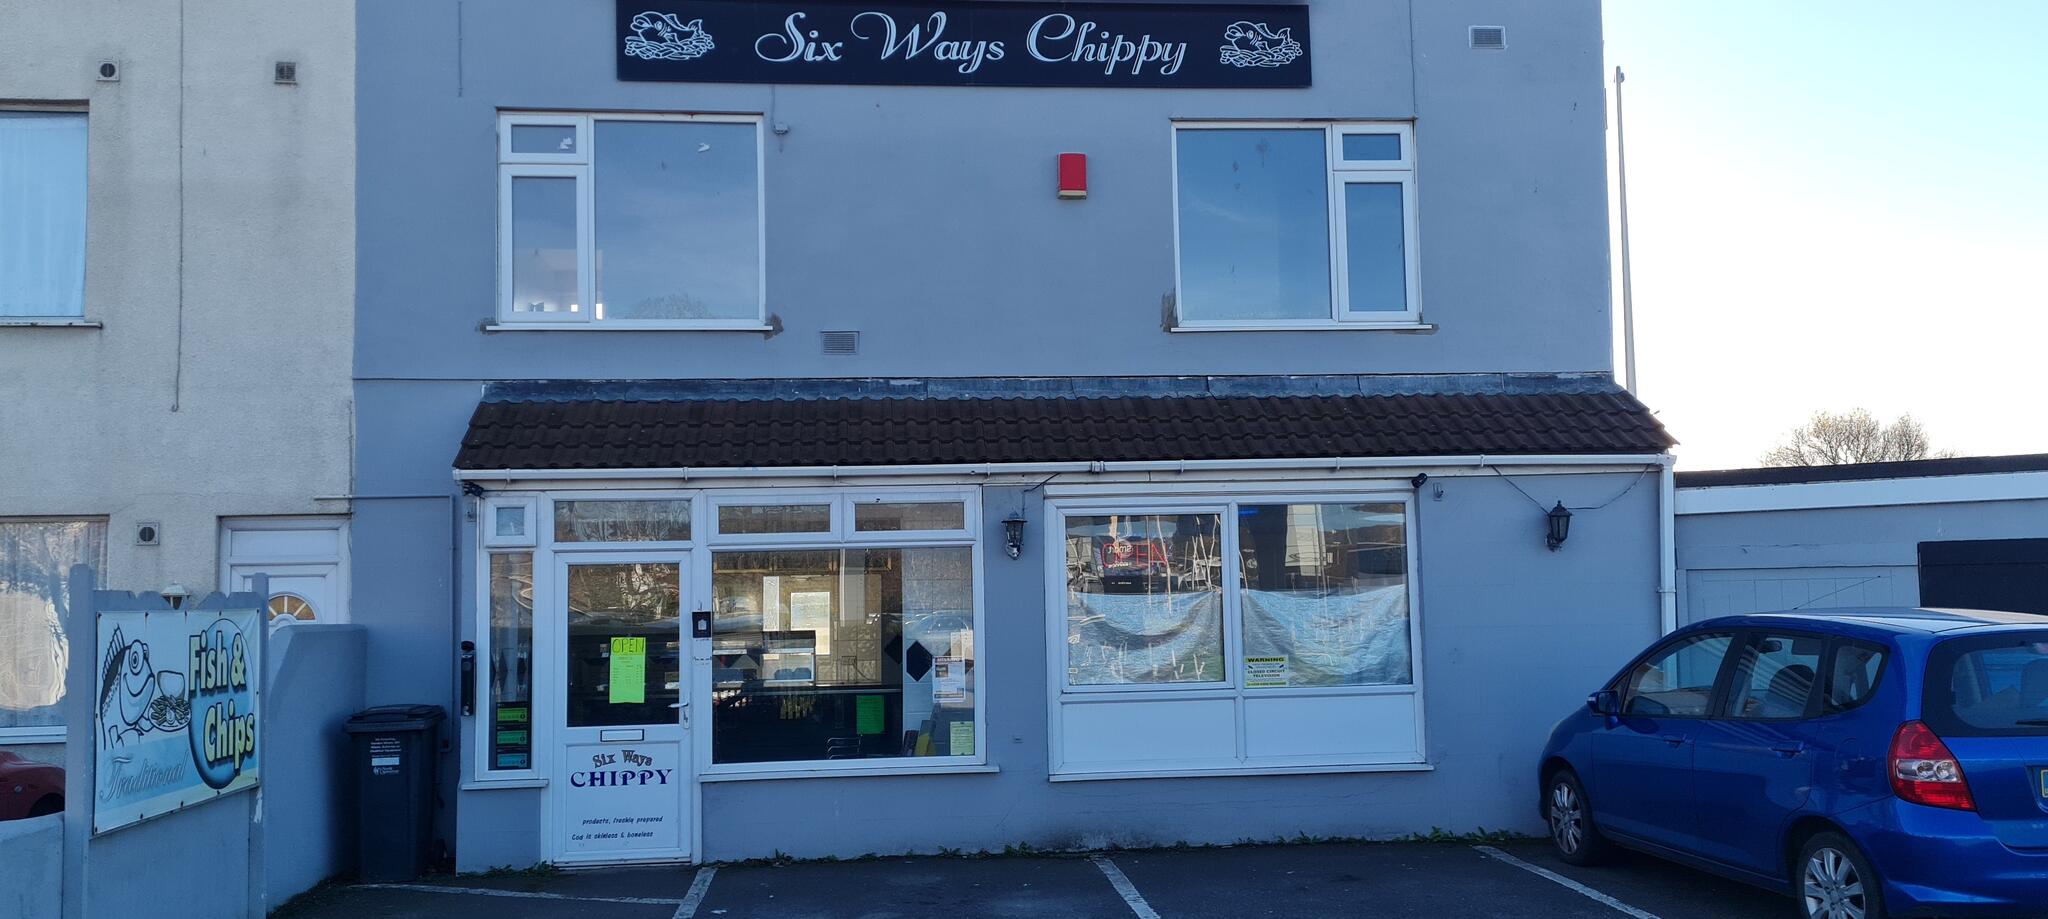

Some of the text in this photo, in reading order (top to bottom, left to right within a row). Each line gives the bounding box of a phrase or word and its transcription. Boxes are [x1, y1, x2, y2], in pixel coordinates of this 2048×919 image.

[755, 11, 1187, 75] Six Ways Chippy
[189, 630, 246, 692] Fish &
[612, 638, 645, 653] OPEN
[203, 699, 255, 772] Chips
[100, 748, 190, 802] Traditional
[592, 749, 653, 768] Six Ways
[570, 769, 673, 788] CHIPPY
[636, 815, 664, 824] prepared
